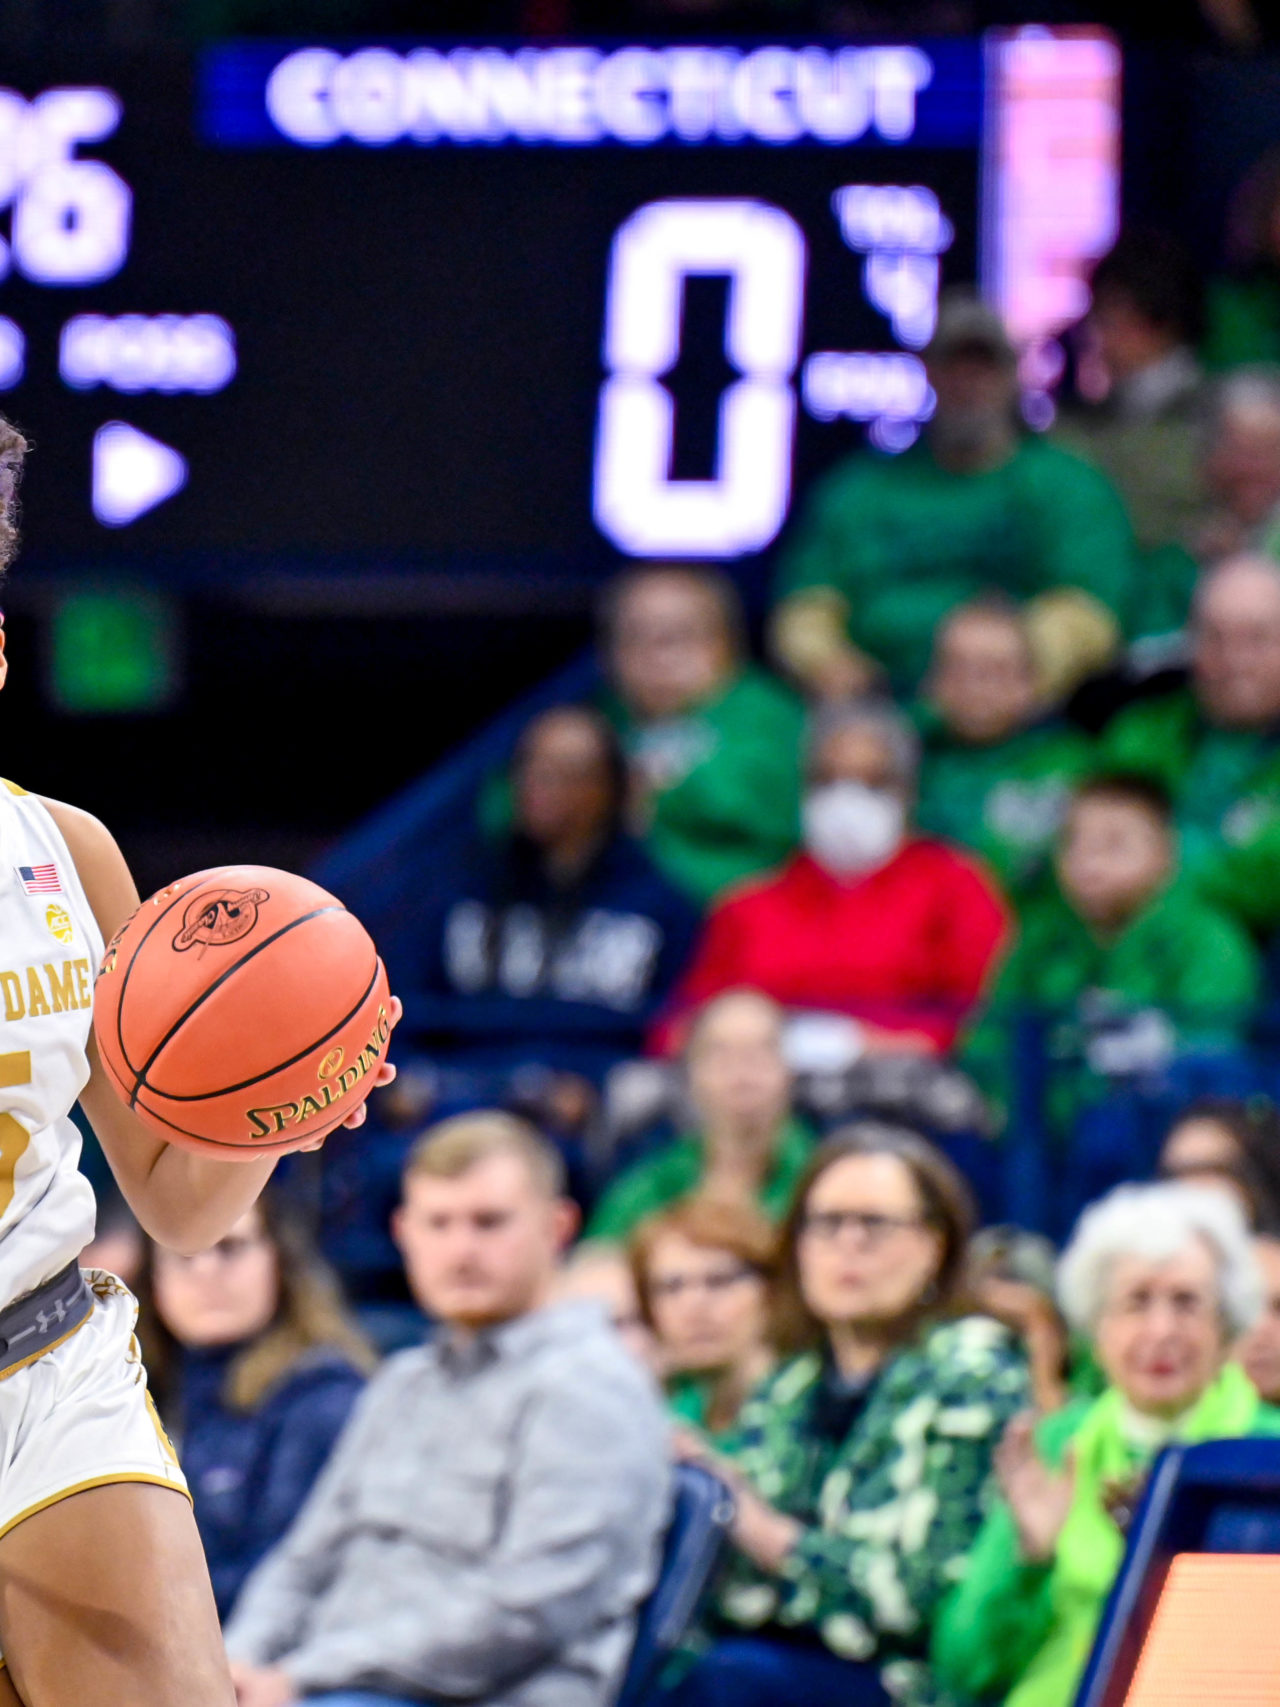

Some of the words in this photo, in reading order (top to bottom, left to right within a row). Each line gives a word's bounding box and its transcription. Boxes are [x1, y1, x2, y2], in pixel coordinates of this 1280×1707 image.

[266, 46, 930, 143] CONNECTICUT
[593, 199, 805, 557] 0
[246, 1004, 392, 1140] SPALDING
